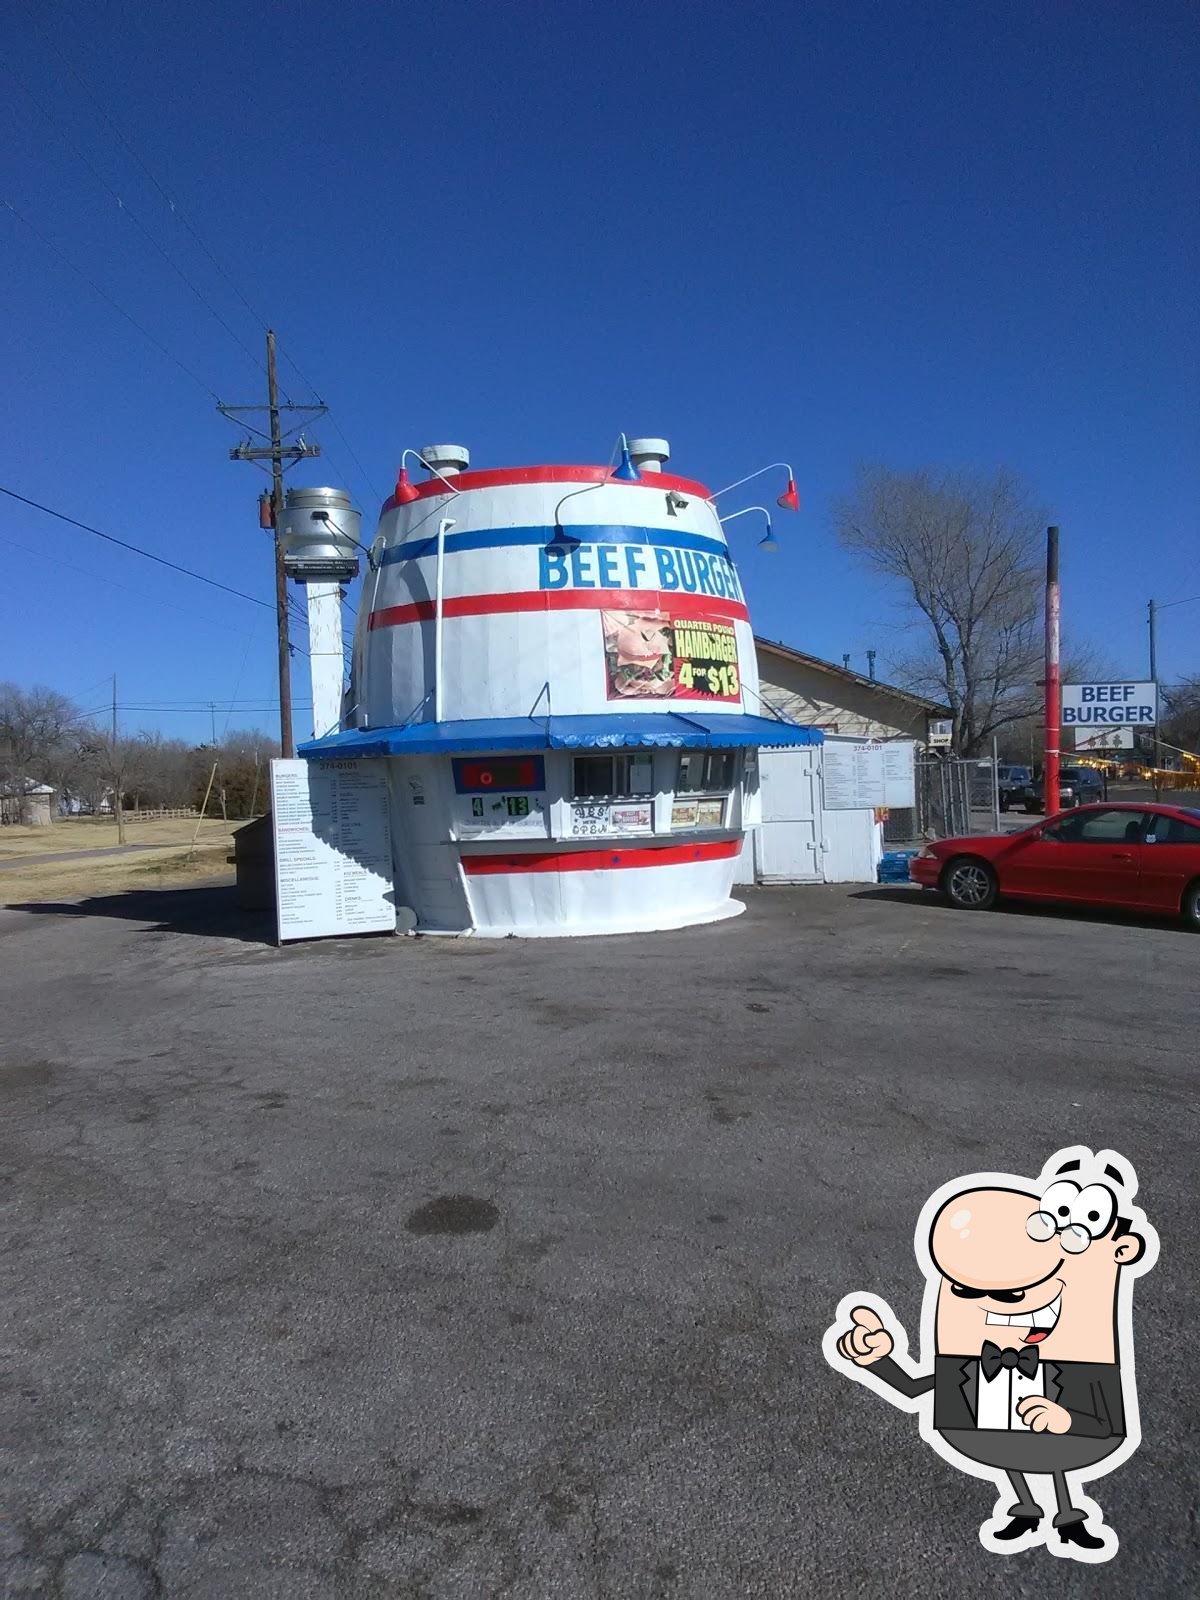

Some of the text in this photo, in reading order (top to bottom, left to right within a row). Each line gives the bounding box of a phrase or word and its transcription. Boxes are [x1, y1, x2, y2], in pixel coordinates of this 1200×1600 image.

[538, 545, 646, 590] BEEF
[673, 620, 735, 635] QUARTER POUND
[674, 629, 738, 663] HAMBURGER
[678, 663, 739, 696] 4 FOR $13
[1081, 685, 1135, 702] BEEF
[1063, 706, 1155, 723] BURGER
[572, 824, 608, 835] OPEN
